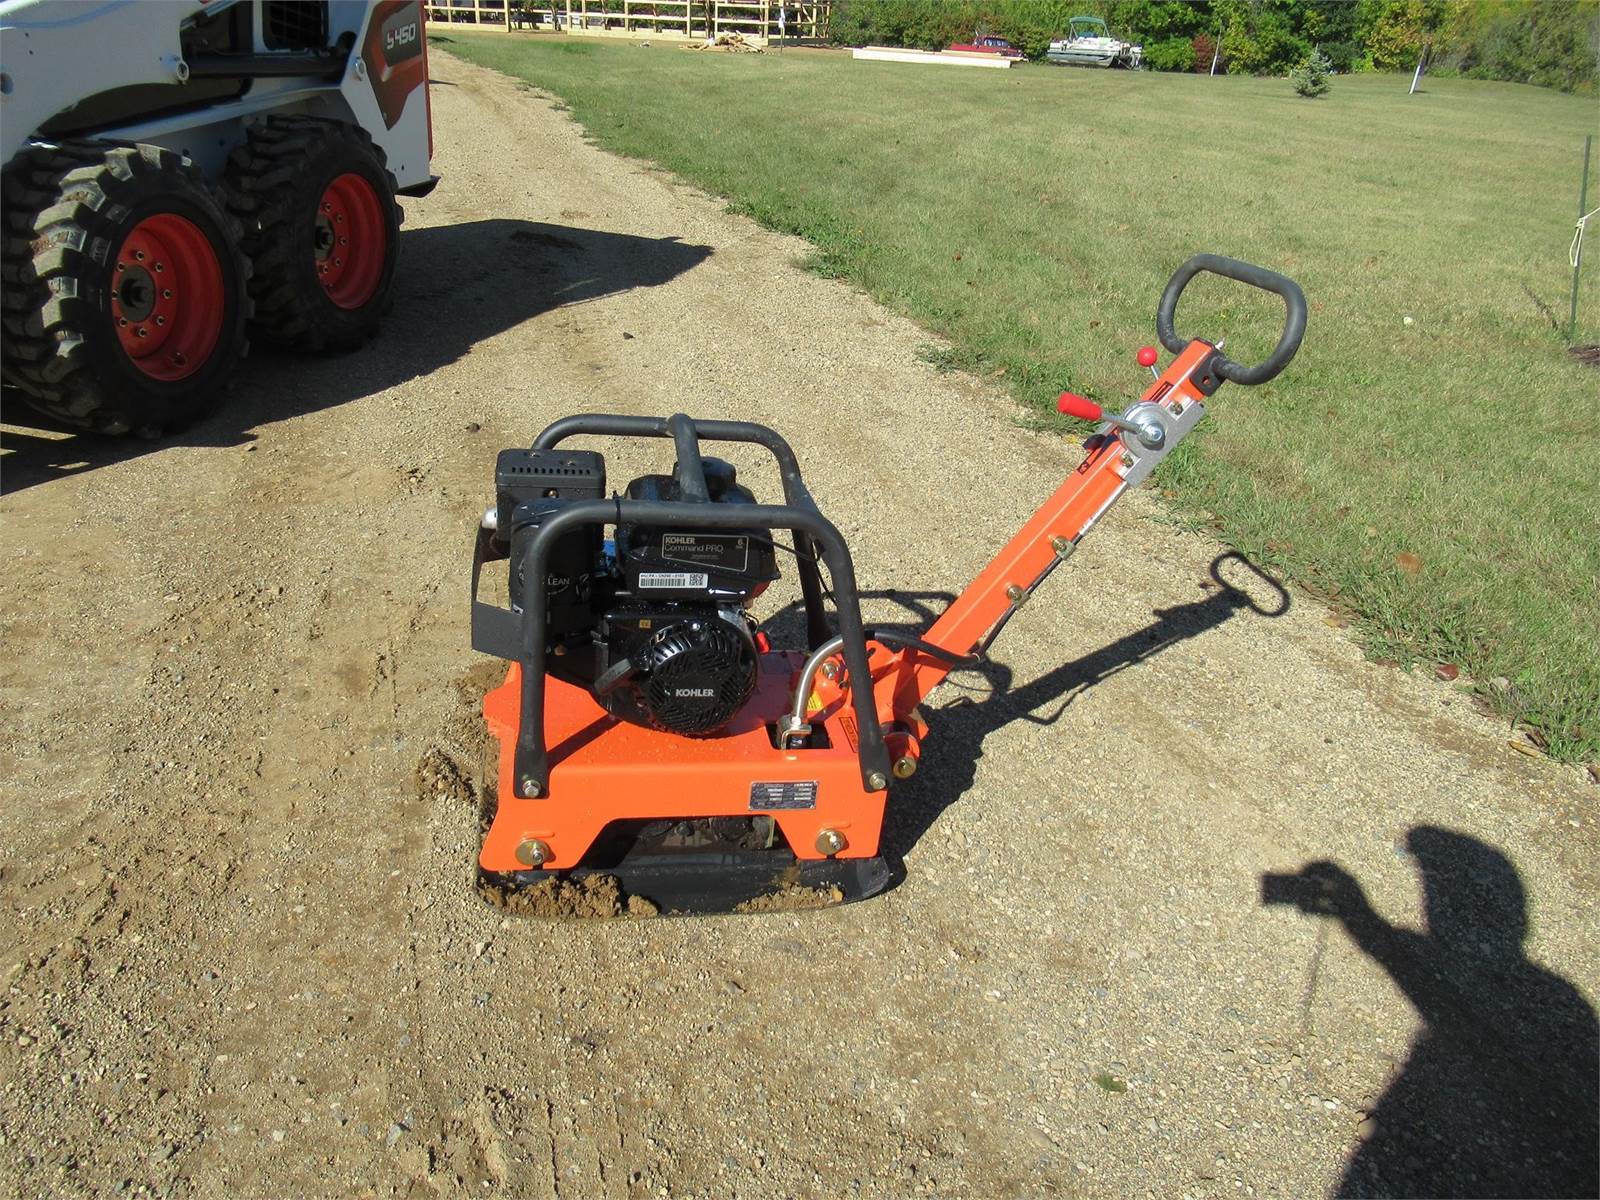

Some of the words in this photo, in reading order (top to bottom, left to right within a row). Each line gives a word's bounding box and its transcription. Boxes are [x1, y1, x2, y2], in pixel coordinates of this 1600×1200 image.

[386, 23, 416, 50] S450
[665, 536, 696, 545] KOHLER
[665, 544, 704, 552] Command
[547, 577, 570, 586] LEAN
[675, 688, 714, 697] KOHLER
